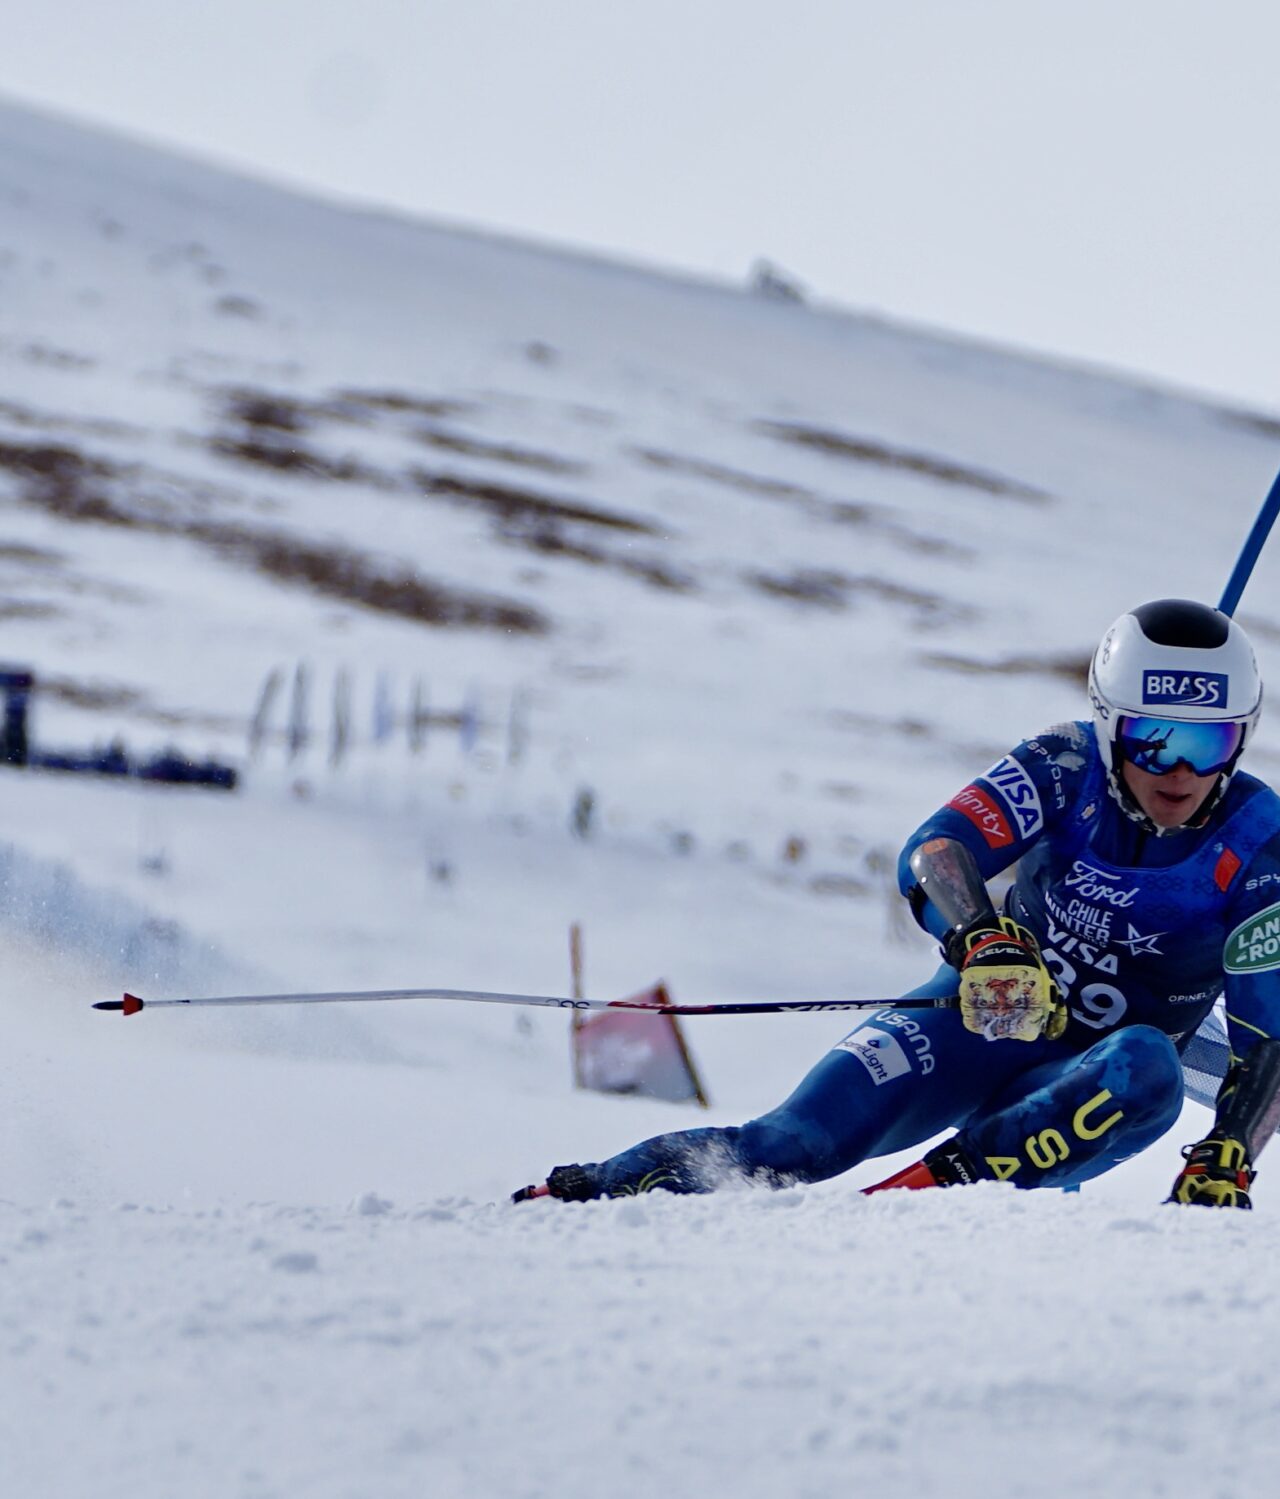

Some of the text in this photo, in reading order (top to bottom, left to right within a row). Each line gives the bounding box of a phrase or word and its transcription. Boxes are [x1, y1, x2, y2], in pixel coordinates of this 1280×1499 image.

[1147, 676, 1219, 704] BRASS
[987, 758, 1039, 833] VISA
[1027, 741, 1066, 810] SPYDER
[1065, 860, 1140, 908] Ford
[1045, 890, 1110, 943] WINTER
[1067, 898, 1114, 929] CHILE
[976, 947, 1024, 959] LEVEL
[1045, 912, 1119, 976] VISA
[875, 1009, 936, 1076] USANA
[984, 1088, 1124, 1181] USA
